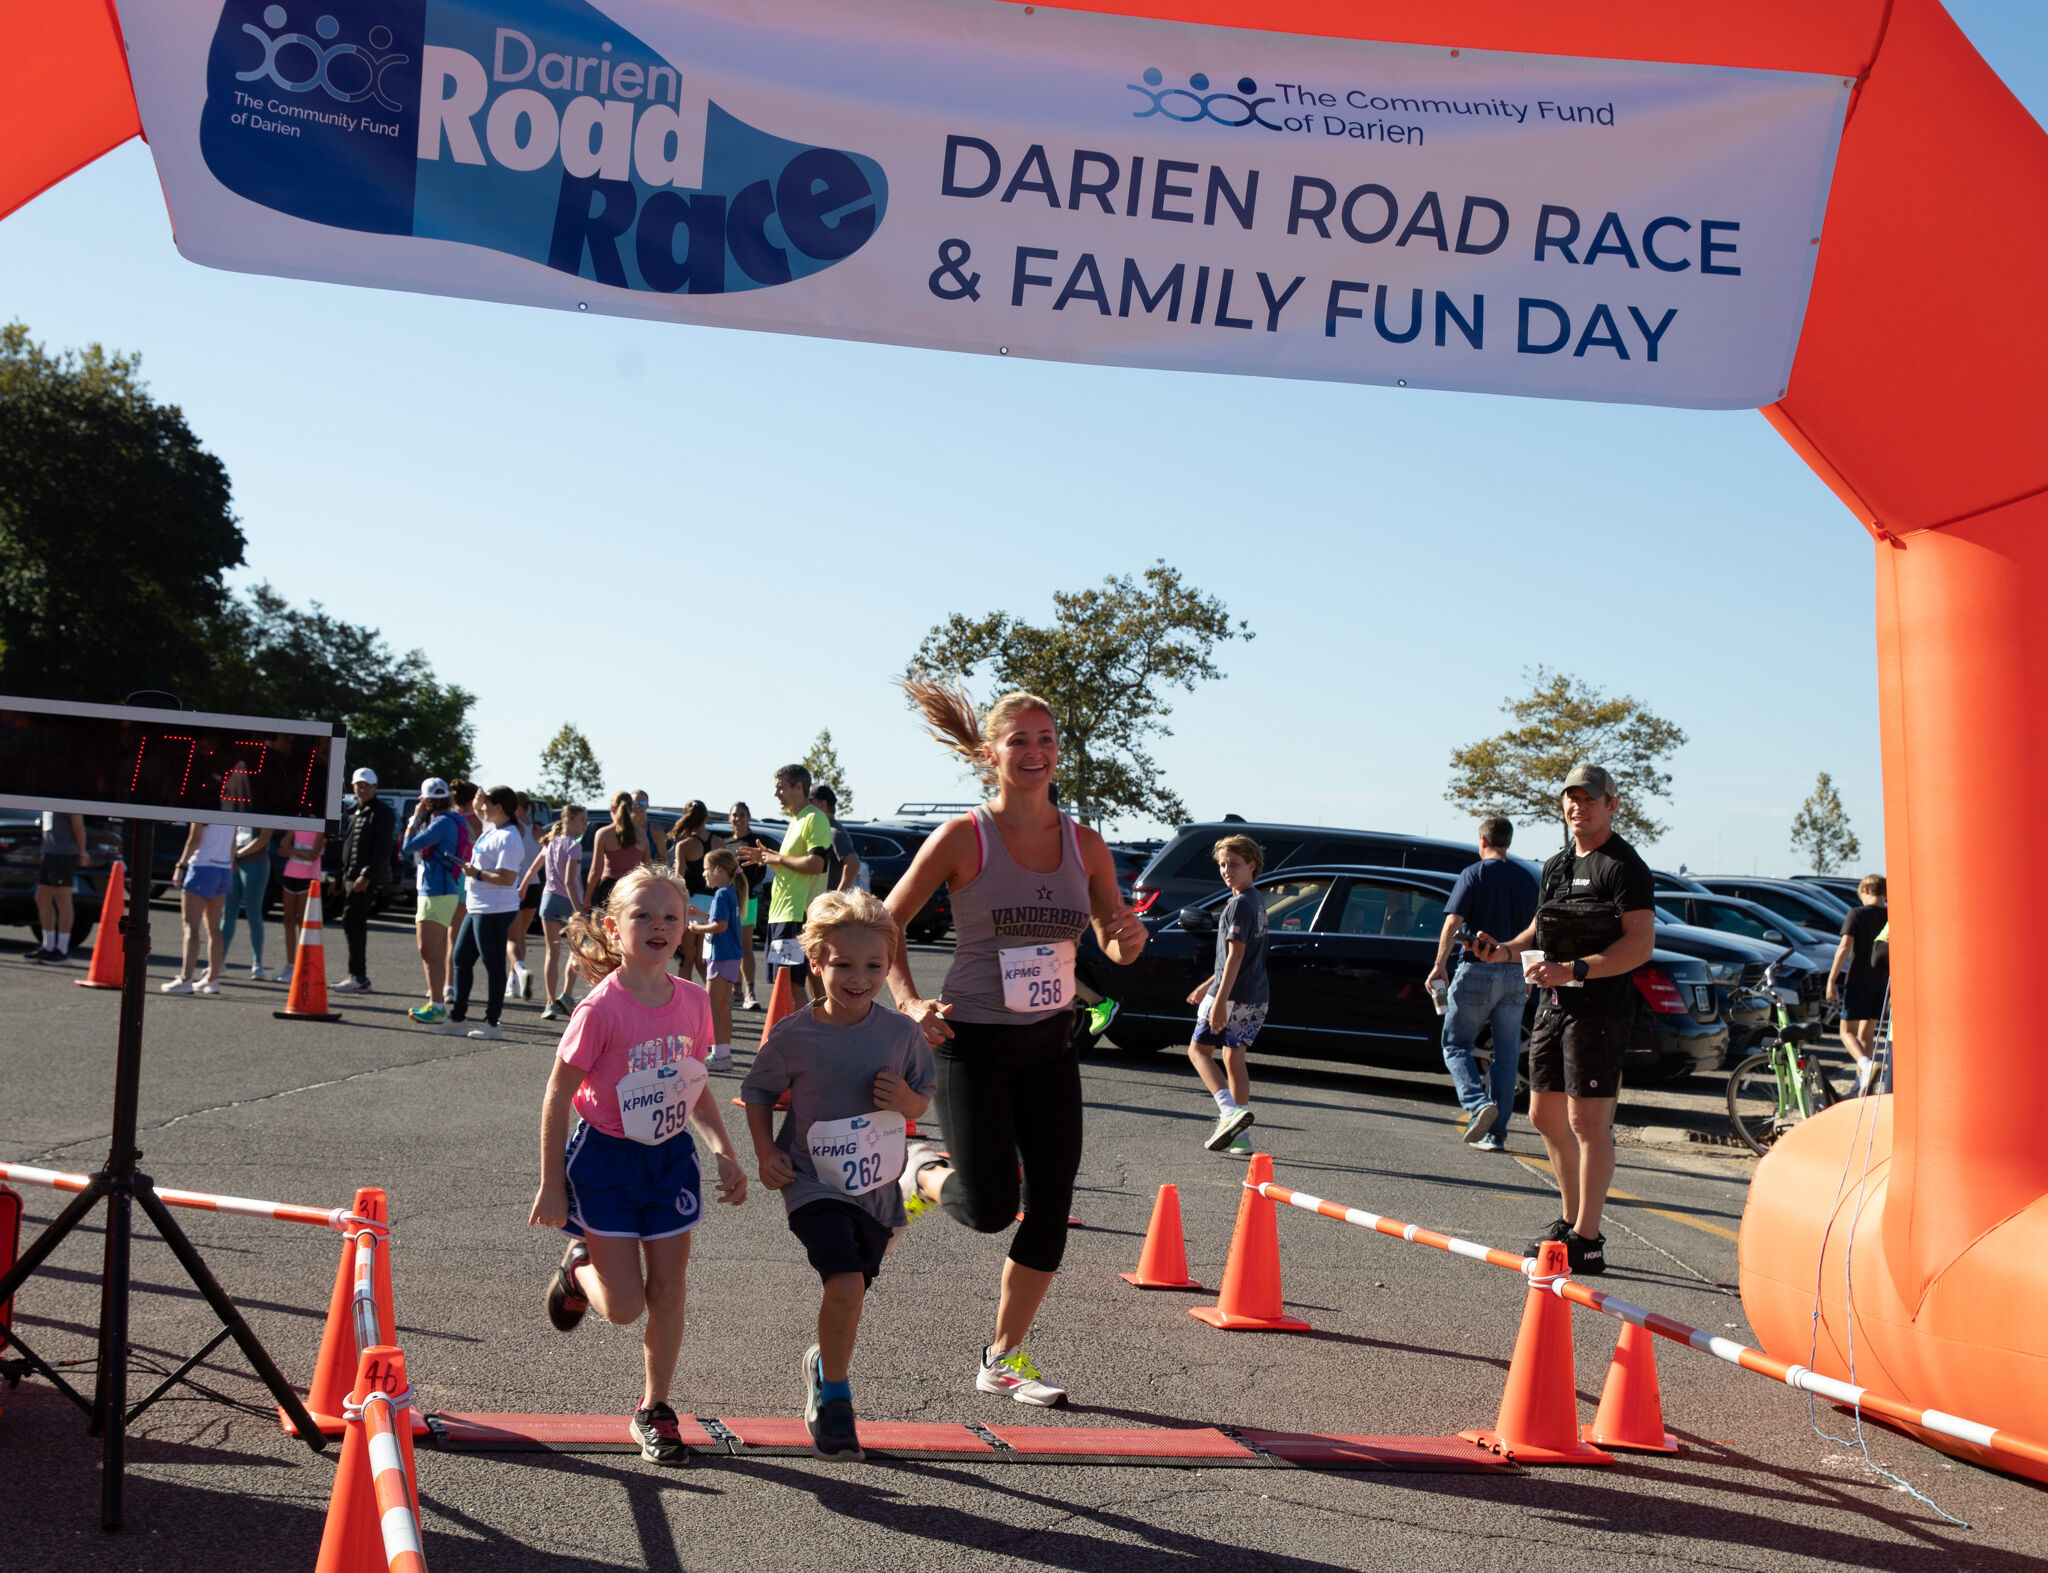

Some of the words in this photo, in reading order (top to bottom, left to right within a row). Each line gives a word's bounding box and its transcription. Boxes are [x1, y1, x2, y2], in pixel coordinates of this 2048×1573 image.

[493, 27, 681, 102] Darien
[234, 90, 264, 110] The
[267, 99, 358, 132] Community
[360, 117, 400, 138] Fund
[416, 44, 709, 191] Road
[1275, 83, 1337, 108] The
[1346, 90, 1529, 124] Community
[1538, 100, 1615, 127] Fund
[230, 112, 249, 126] of
[250, 114, 301, 138] Darien
[1283, 114, 1314, 134] of
[1324, 115, 1424, 147] Darien
[547, 147, 877, 295] Race
[940, 134, 1260, 231] DARIEN
[1286, 175, 1510, 256] ROAD
[1533, 204, 1742, 277] RACE
[928, 238, 982, 303] &
[1010, 245, 1307, 333] FAMILY
[1324, 279, 1485, 350] FUN
[1516, 296, 1679, 363] DAY
[1004, 966, 1042, 980] KPMG
[1028, 978, 1062, 1007] 258
[623, 1091, 664, 1112] KPMG
[652, 1100, 687, 1140] 259
[812, 1142, 857, 1157] KPMG
[843, 1152, 882, 1191] 262
[359, 1199, 378, 1224] 31
[1583, 1250, 1602, 1260] HOKA
[365, 1360, 398, 1394] 46
